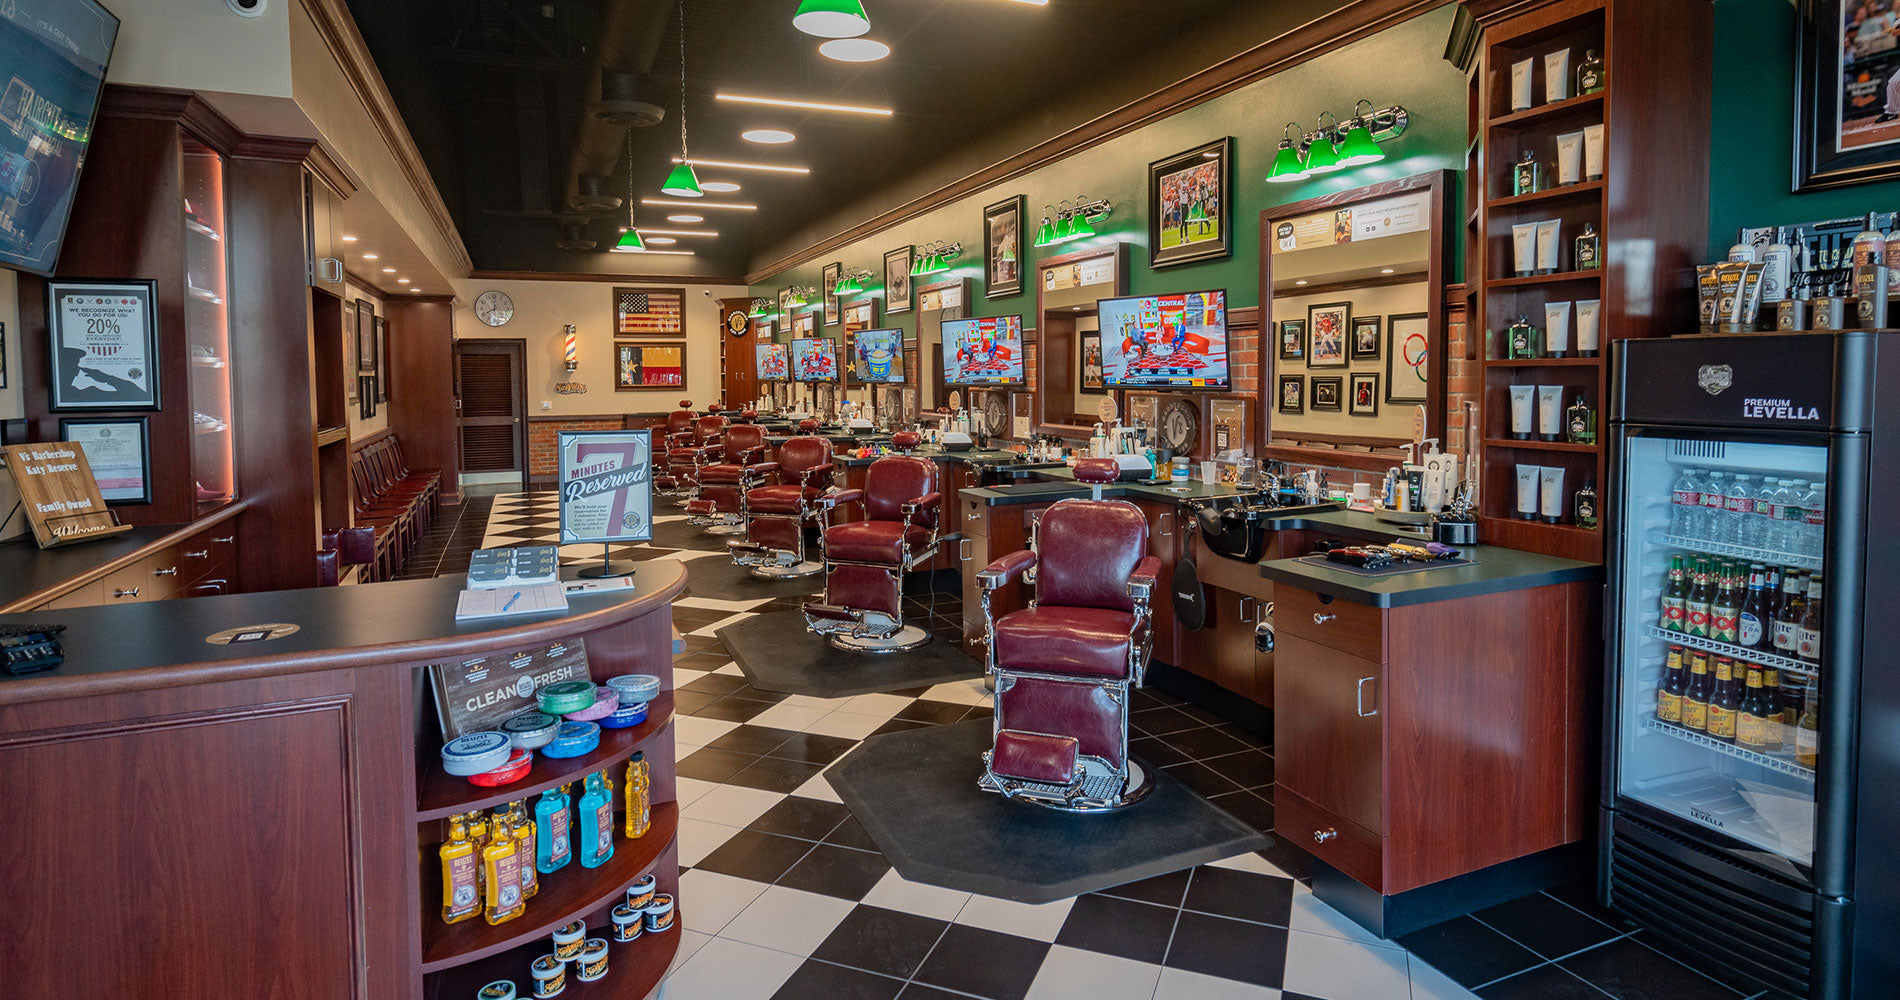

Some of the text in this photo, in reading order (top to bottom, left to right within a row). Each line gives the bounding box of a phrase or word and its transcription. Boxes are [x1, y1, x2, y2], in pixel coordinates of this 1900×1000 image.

[1720, 273, 1740, 282] REUZEL
[1158, 299, 1185, 307] CENTRAL
[86, 318, 120, 334] 20%
[1744, 398, 1790, 407] PREMIUM
[1743, 406, 1819, 420] LEVELLA
[32, 449, 76, 460] Barbershop
[25, 463, 78, 475] Katy Reserve
[571, 460, 616, 479] MINUTES
[565, 462, 648, 503] Reserved
[36, 498, 92, 512] Family Owned
[1775, 622, 1792, 633] Lite
[1799, 629, 1816, 641] Lite
[465, 684, 517, 712] CLEAN
[533, 665, 573, 689] FRESH
[1690, 810, 1723, 827] LEVELLA
